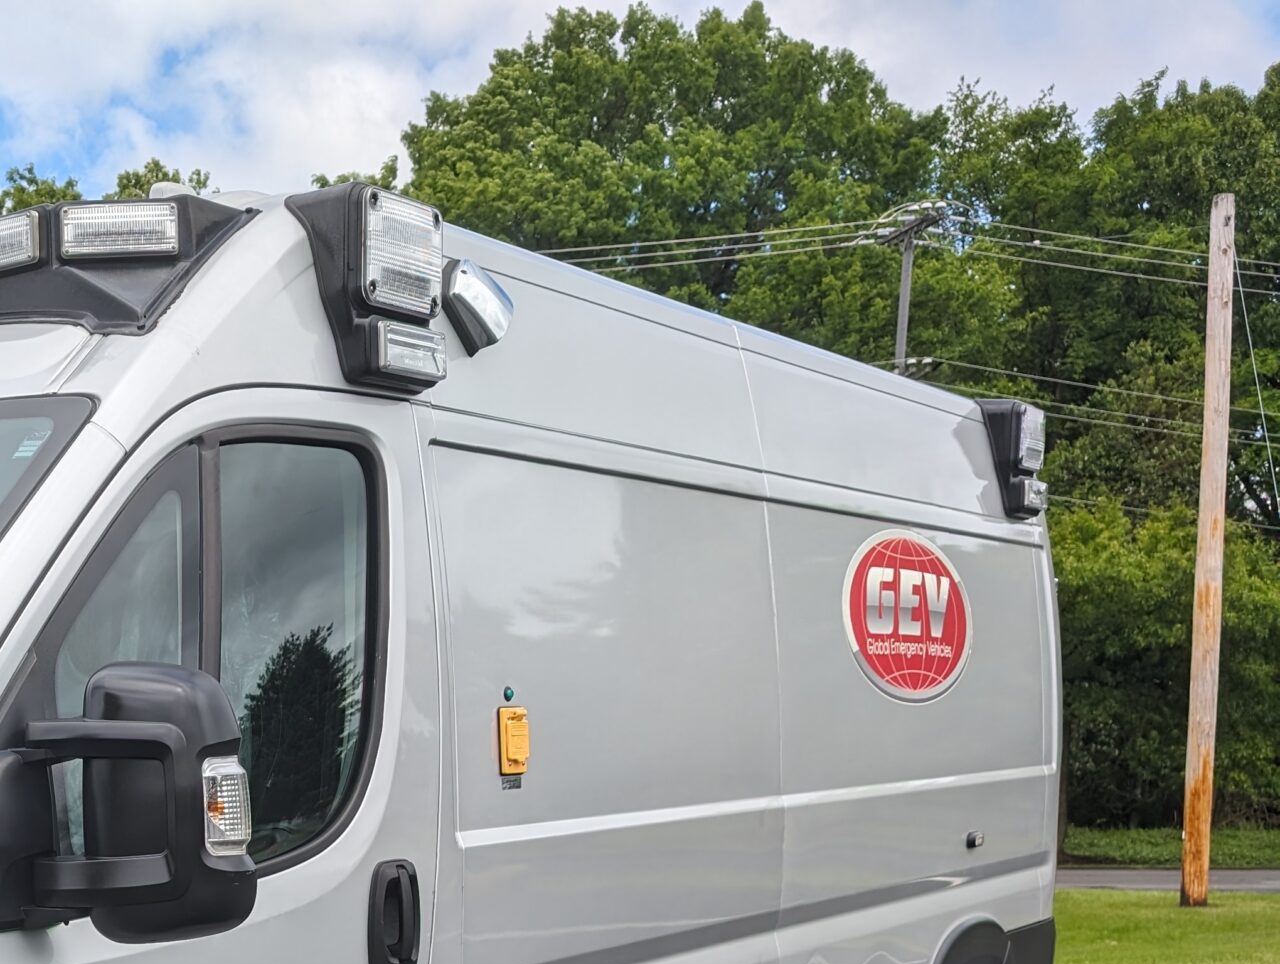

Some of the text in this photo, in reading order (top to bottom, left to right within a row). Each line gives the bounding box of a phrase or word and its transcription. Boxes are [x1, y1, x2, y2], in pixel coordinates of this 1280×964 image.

[866, 566, 950, 638] GEV
[867, 638, 952, 659] Global Emergency Vehicles
